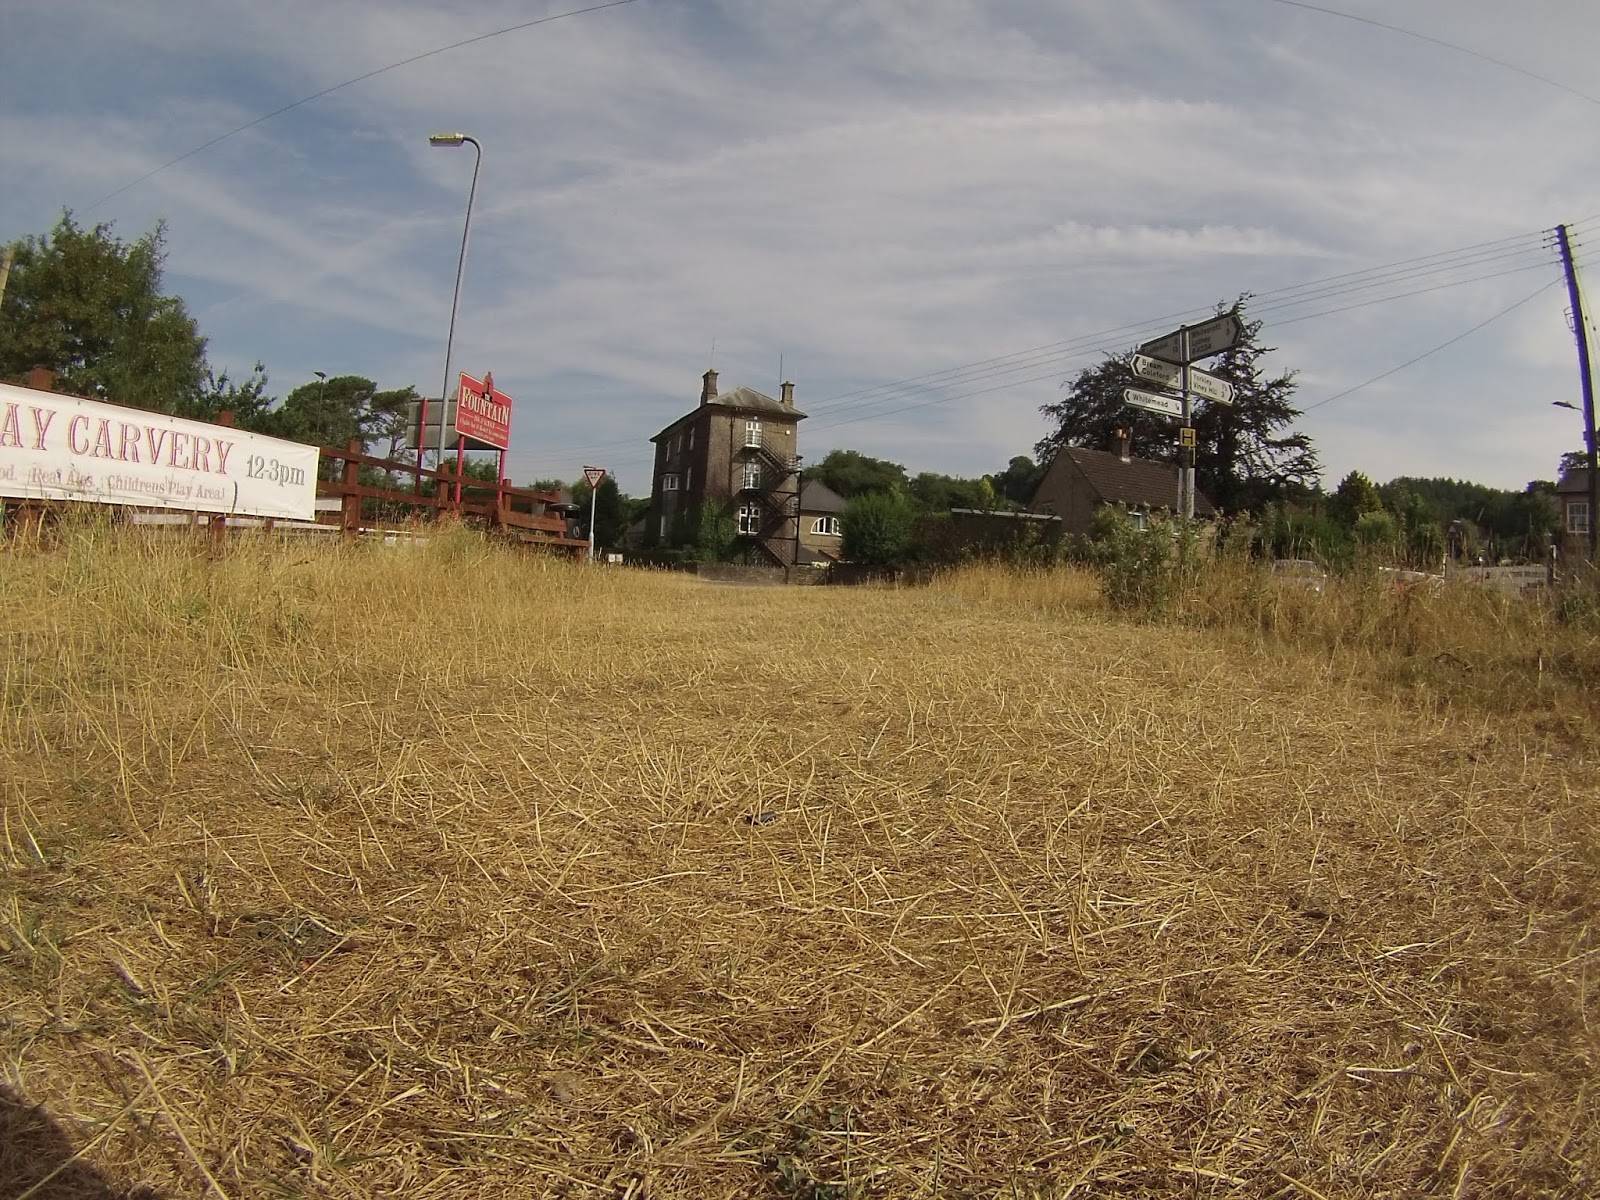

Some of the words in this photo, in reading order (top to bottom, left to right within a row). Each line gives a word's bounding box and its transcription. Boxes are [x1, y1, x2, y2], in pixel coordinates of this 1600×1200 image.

[1142, 359, 1163, 370] Bream
[1141, 367, 1170, 381] Coleford
[460, 385, 510, 426] FOUNTAIN
[1132, 393, 1168, 408] Whitemead
[1182, 430, 1193, 444] H
[67, 414, 234, 475] CARVERY
[246, 454, 305, 487] 12-3pm
[108, 474, 165, 493] Childrens
[168, 481, 193, 499] Play
